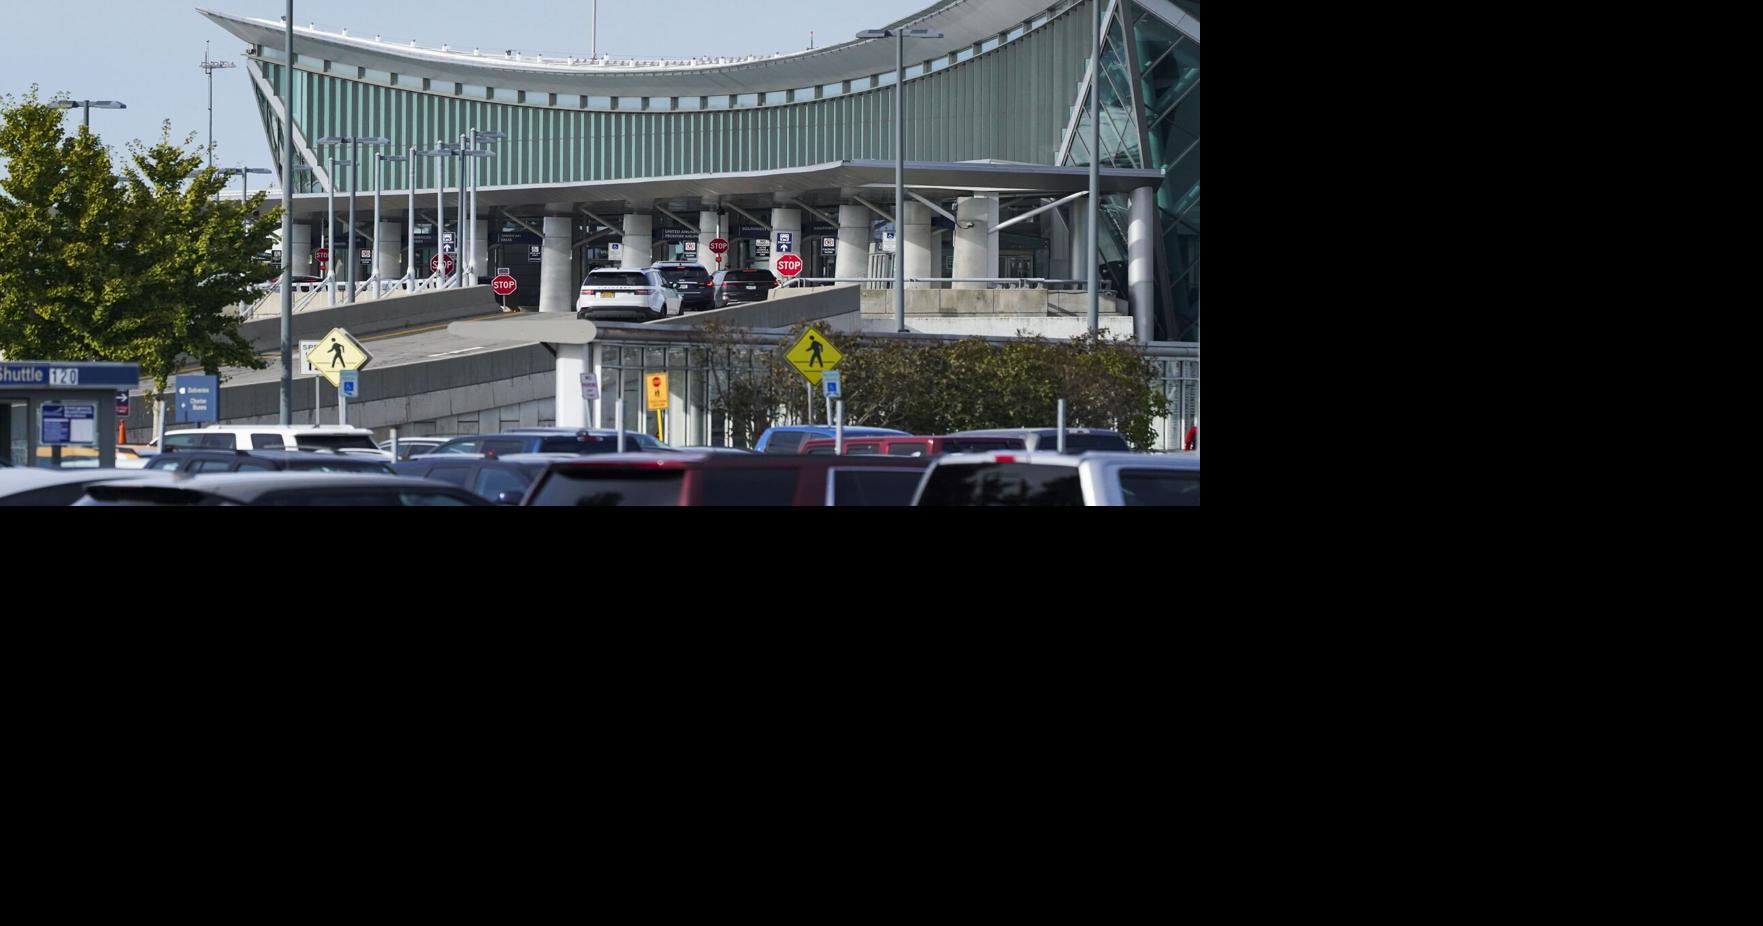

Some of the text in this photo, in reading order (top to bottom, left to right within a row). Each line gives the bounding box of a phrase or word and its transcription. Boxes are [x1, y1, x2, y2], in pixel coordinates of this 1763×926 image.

[710, 242, 728, 250] STOP
[432, 260, 453, 269] SOP
[778, 261, 800, 270] STOP
[493, 281, 515, 289] STOP
[51, 370, 77, 383] 120
